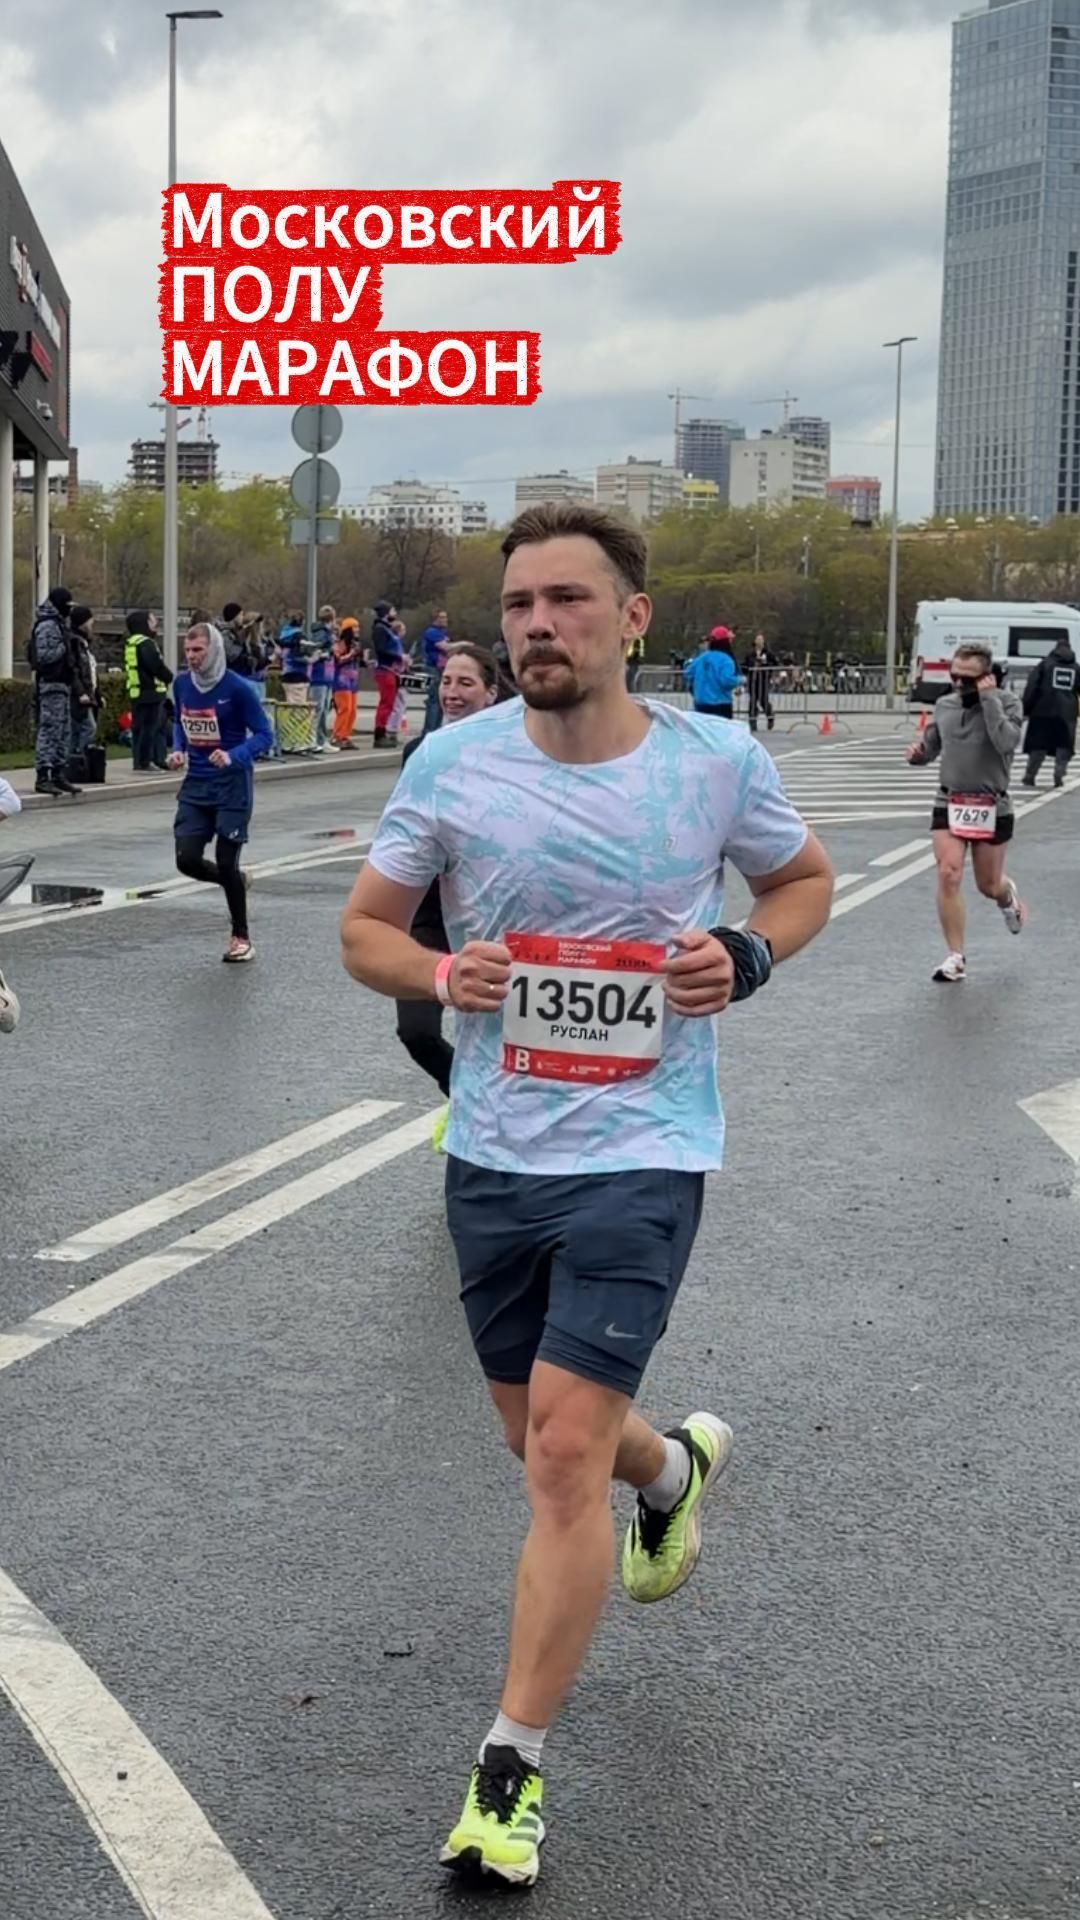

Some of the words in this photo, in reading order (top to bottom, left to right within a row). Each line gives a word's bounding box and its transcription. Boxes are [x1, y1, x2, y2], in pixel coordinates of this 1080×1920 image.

[182, 718, 217, 733] 12570
[953, 808, 989, 823] 7679
[512, 976, 656, 1028] 13504
[551, 1024, 609, 1041] РУСЛАН
